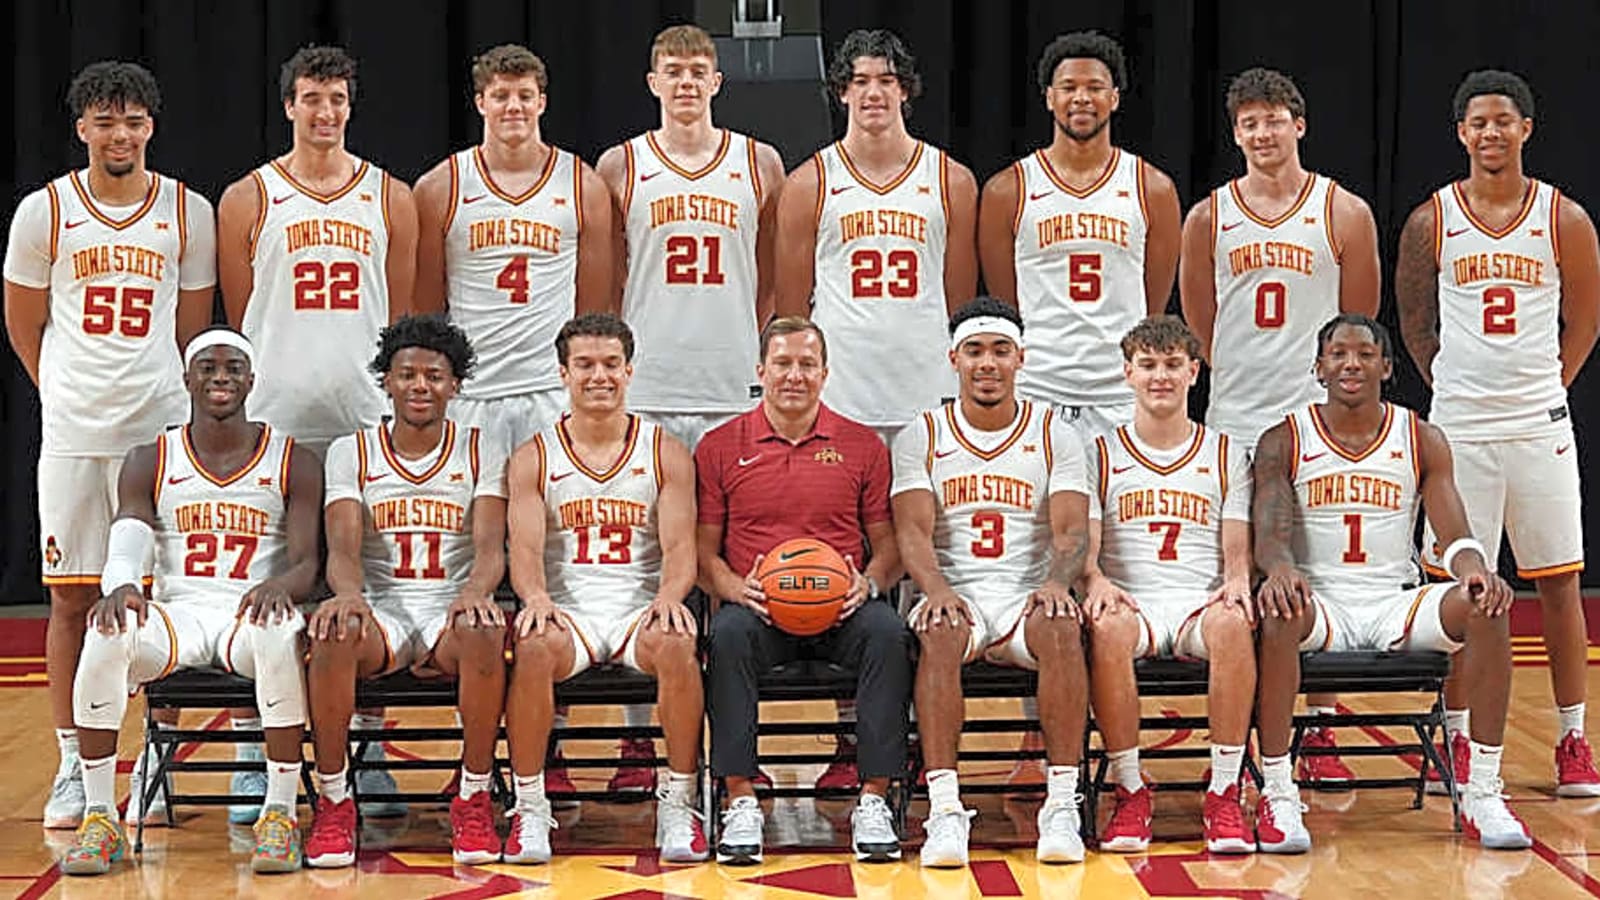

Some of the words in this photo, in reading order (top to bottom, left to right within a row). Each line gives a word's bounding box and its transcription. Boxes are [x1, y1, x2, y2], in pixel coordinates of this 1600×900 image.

[651, 194, 686, 229] IOWA
[688, 194, 738, 230] STATE
[840, 209, 875, 244] IOWA
[877, 209, 927, 244] STATE
[1038, 214, 1075, 248] IOWA
[1078, 213, 1128, 248] STATE
[286, 220, 321, 254] IOWA
[323, 219, 372, 256] STATE
[469, 219, 507, 252] IOWA
[510, 219, 561, 254] STATE
[72, 245, 110, 281] IOWA
[112, 245, 165, 282] STATE
[666, 236, 725, 285] 21
[850, 249, 919, 299] 23
[1229, 243, 1264, 276] IOWA
[1265, 241, 1313, 276] STATE
[1453, 254, 1489, 285] IOWA
[1490, 253, 1543, 287] STATE
[293, 261, 360, 310] 22
[496, 254, 530, 304] 4
[1069, 253, 1103, 302] 5
[82, 285, 154, 338] 55
[1255, 282, 1287, 330] 0
[1483, 286, 1517, 335] 2
[941, 474, 979, 507] IOWA
[982, 474, 1034, 510] STATE
[1119, 489, 1155, 523] IOWA
[1159, 489, 1211, 526] STATE
[1307, 474, 1346, 508] IOWA
[1350, 475, 1402, 511] STATE
[175, 502, 212, 533] IOWA
[215, 502, 269, 535] STATE
[371, 499, 408, 531] IOWA
[412, 499, 465, 533] STATE
[559, 499, 595, 530] IOWA
[597, 498, 648, 527] STATE
[571, 526, 632, 564] 13
[970, 509, 1005, 559] 3
[1148, 522, 1182, 561] 7
[1342, 514, 1368, 564] 1
[184, 533, 259, 580] 27
[392, 531, 446, 580] 11
[778, 575, 831, 591] ELITE
